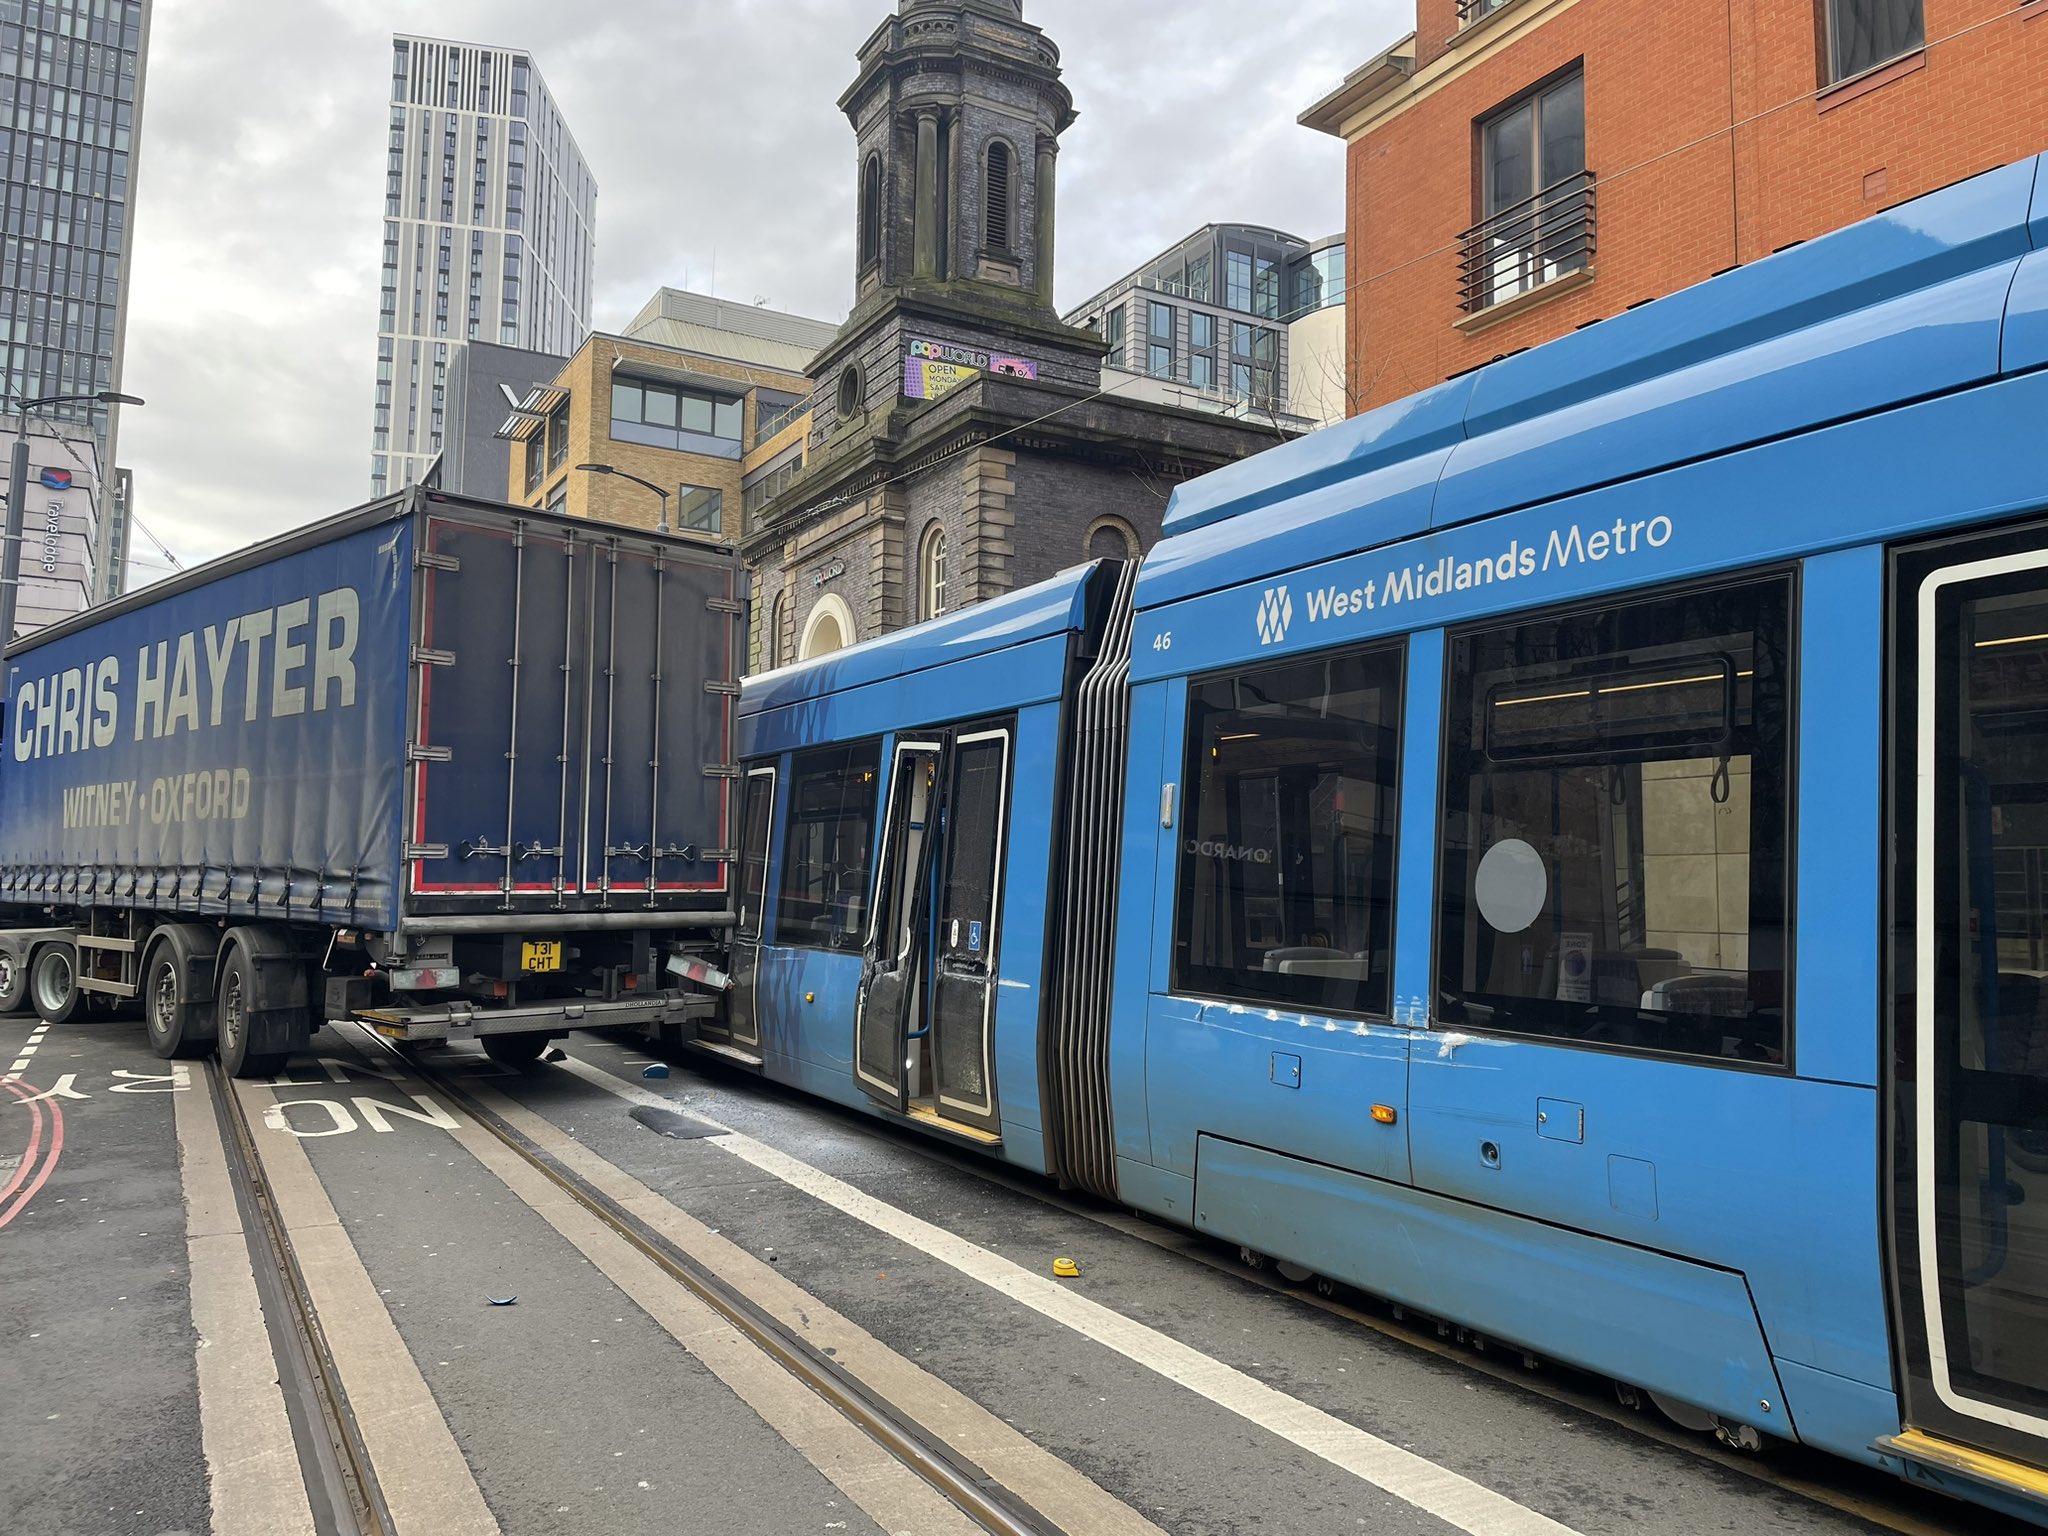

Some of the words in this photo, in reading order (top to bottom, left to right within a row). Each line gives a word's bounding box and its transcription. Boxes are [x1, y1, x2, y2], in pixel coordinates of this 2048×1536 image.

[928, 364, 957, 375] OPEN
[41, 498, 66, 573] Travelodge
[1306, 577, 1376, 622] West
[1380, 540, 1537, 608] Midlands
[1541, 515, 1673, 572] Metro
[1153, 631, 1172, 651] 46
[13, 655, 120, 763] CHRIS
[134, 586, 361, 742] HAYTER
[62, 780, 137, 830] WITNEY
[150, 767, 251, 825] OXFORD
[528, 956, 553, 970] CHT
[262, 1094, 463, 1138] NO
